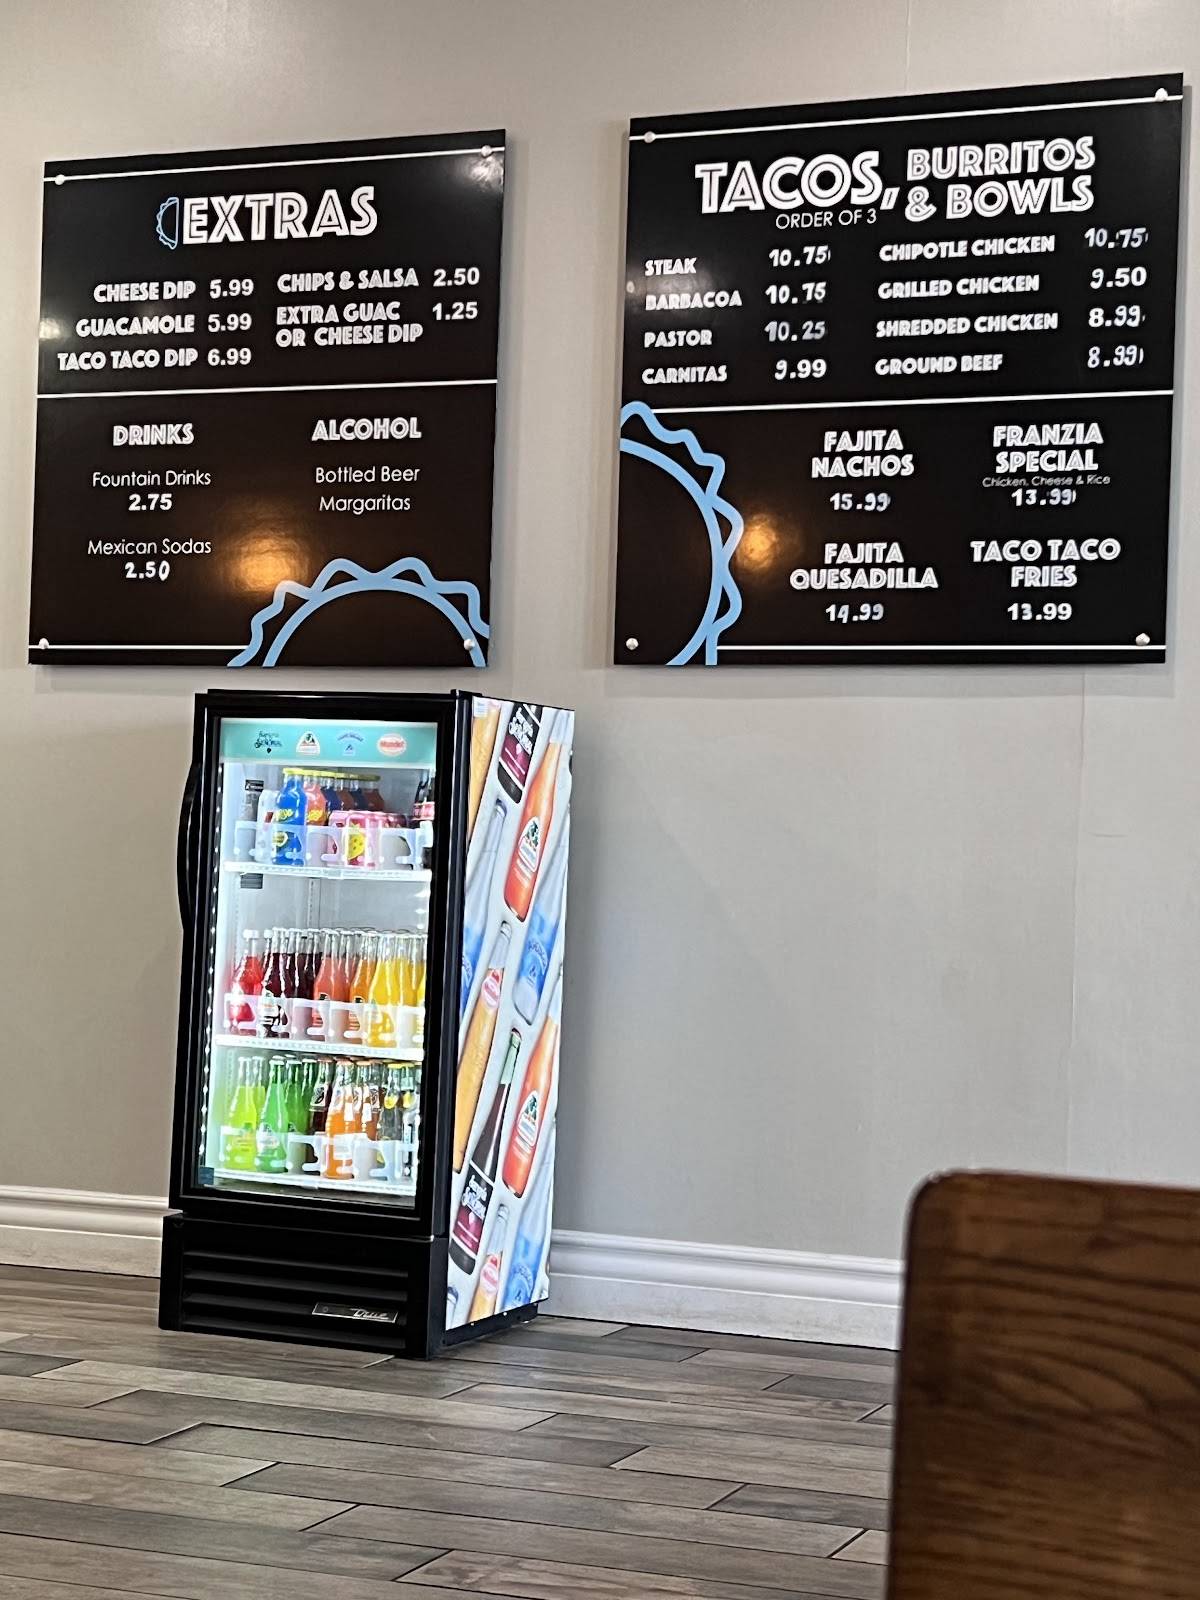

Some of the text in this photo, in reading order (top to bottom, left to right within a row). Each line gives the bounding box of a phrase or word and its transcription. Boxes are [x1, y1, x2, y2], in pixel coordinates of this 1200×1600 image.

[907, 136, 1095, 181] BURRITOS
[695, 151, 900, 214] TACOS,
[905, 175, 1094, 221] & BOWLS
[183, 186, 377, 244] EXTRAS
[776, 208, 876, 229] ORDER OF 3
[880, 241, 967, 261] CHIPOTLE
[971, 235, 1055, 256] CHICKEN
[645, 257, 697, 276] STEAK
[94, 279, 253, 302] CHEESE DIP 5.99
[277, 267, 479, 292] CHIPS & SALSA 2.50
[878, 267, 1146, 299] GRILLED CHICKEN 9.50
[646, 282, 826, 311] BARBACOA 10.75
[76, 313, 251, 337] GUACAMOLE 5.99
[277, 302, 477, 325] EXTRA GUAC 1.25
[877, 318, 970, 337] SHREDDED
[974, 313, 1058, 332] CHICKEN
[276, 324, 423, 347] OR CHEESE DIP
[645, 321, 825, 347] PASTOR 10.25
[58, 348, 251, 370] TACO TACO DIP 6.99
[875, 357, 957, 375] GROUND
[961, 354, 1002, 371] BEEF
[642, 359, 826, 384] CARNITAS 9.99
[113, 423, 194, 445] DRINKS
[312, 417, 421, 441] ALCOHOL
[993, 423, 1103, 447] FRANZIA
[824, 430, 903, 452] FAJITA
[812, 453, 914, 478] NACHOS
[996, 449, 1098, 473] SPECIAL
[93, 470, 211, 487] Fountain Drinks
[316, 466, 419, 483] Bottled Beer
[1032, 476, 1073, 486] Cheese
[1076, 476, 1084, 484] &
[1087, 475, 1110, 484] Rice
[129, 494, 172, 510] 2.75
[320, 495, 410, 514] Margaritas
[88, 539, 211, 554] Mexican Sodas
[825, 543, 904, 564] FAJITA
[971, 538, 1120, 562] TACO TACO
[125, 561, 170, 580] 2.50
[790, 568, 938, 589] QUESADILLA
[1011, 565, 1077, 587] FRIES
[1008, 603, 1071, 620] 13.99
